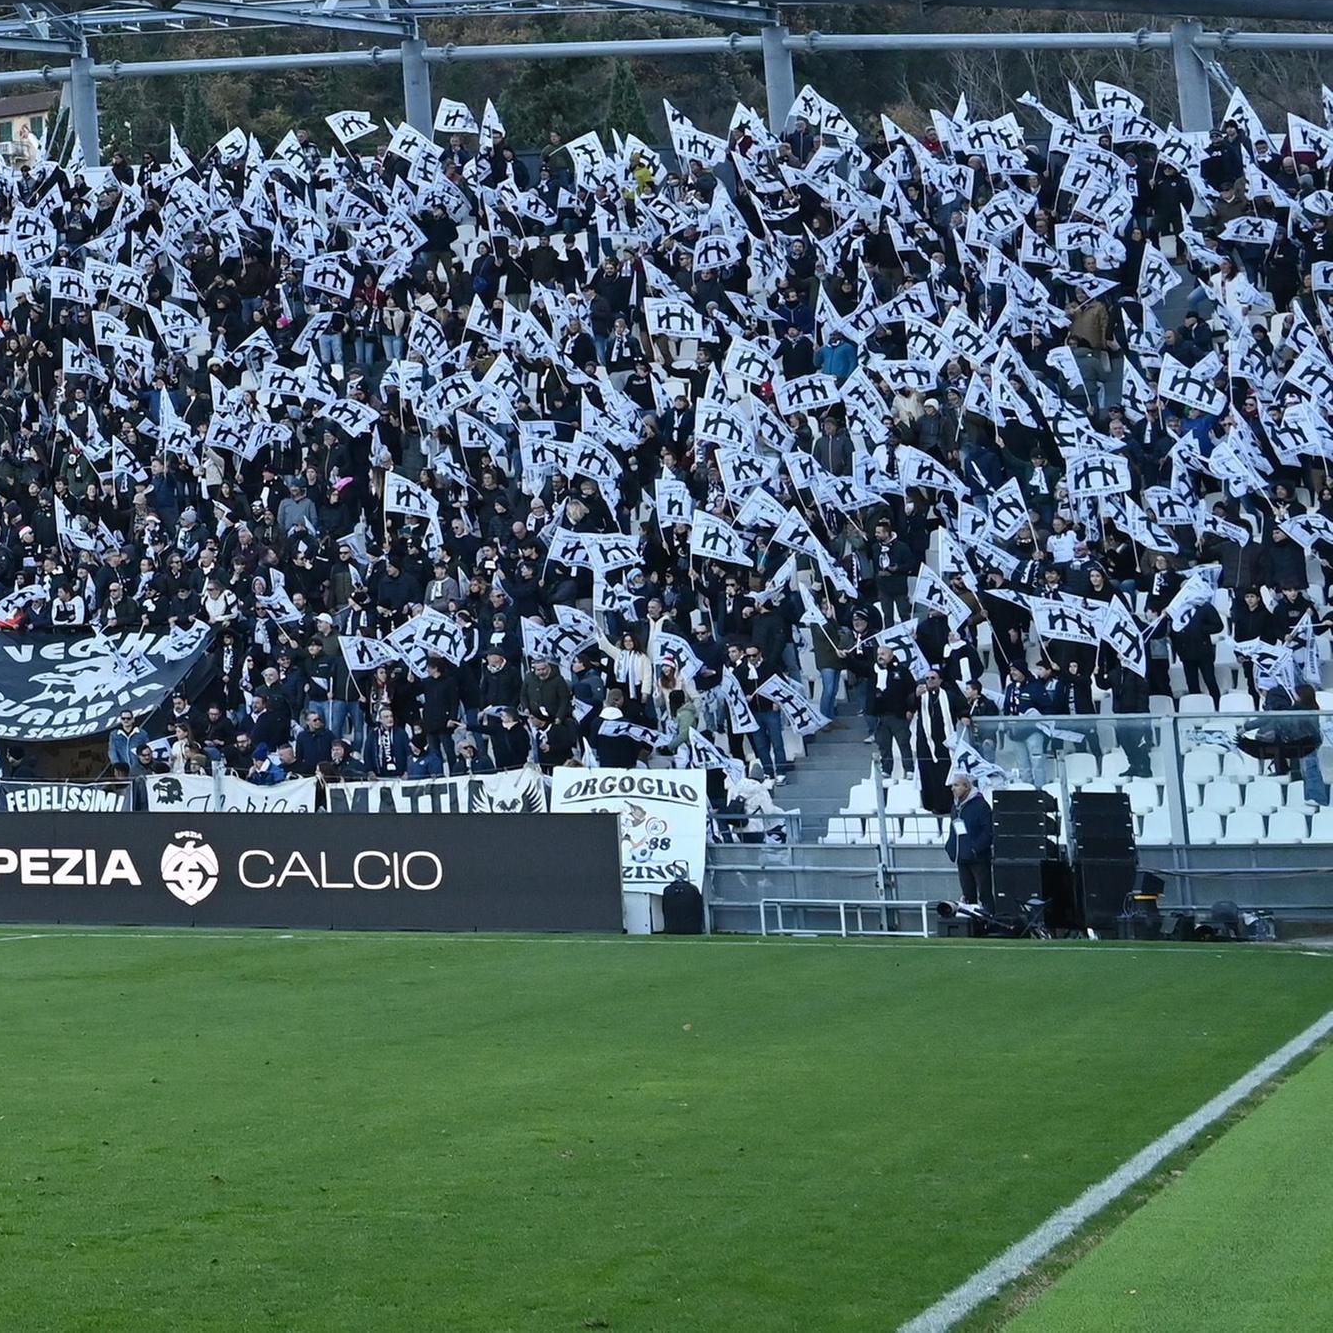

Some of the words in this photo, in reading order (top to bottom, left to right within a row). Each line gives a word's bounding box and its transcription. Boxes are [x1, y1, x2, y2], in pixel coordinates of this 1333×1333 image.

[23, 719, 97, 739] SPEZIA
[6, 785, 125, 812] FEDELISSIMI
[563, 775, 698, 802] ORGOGLIO
[239, 850, 443, 890] CALCIO
